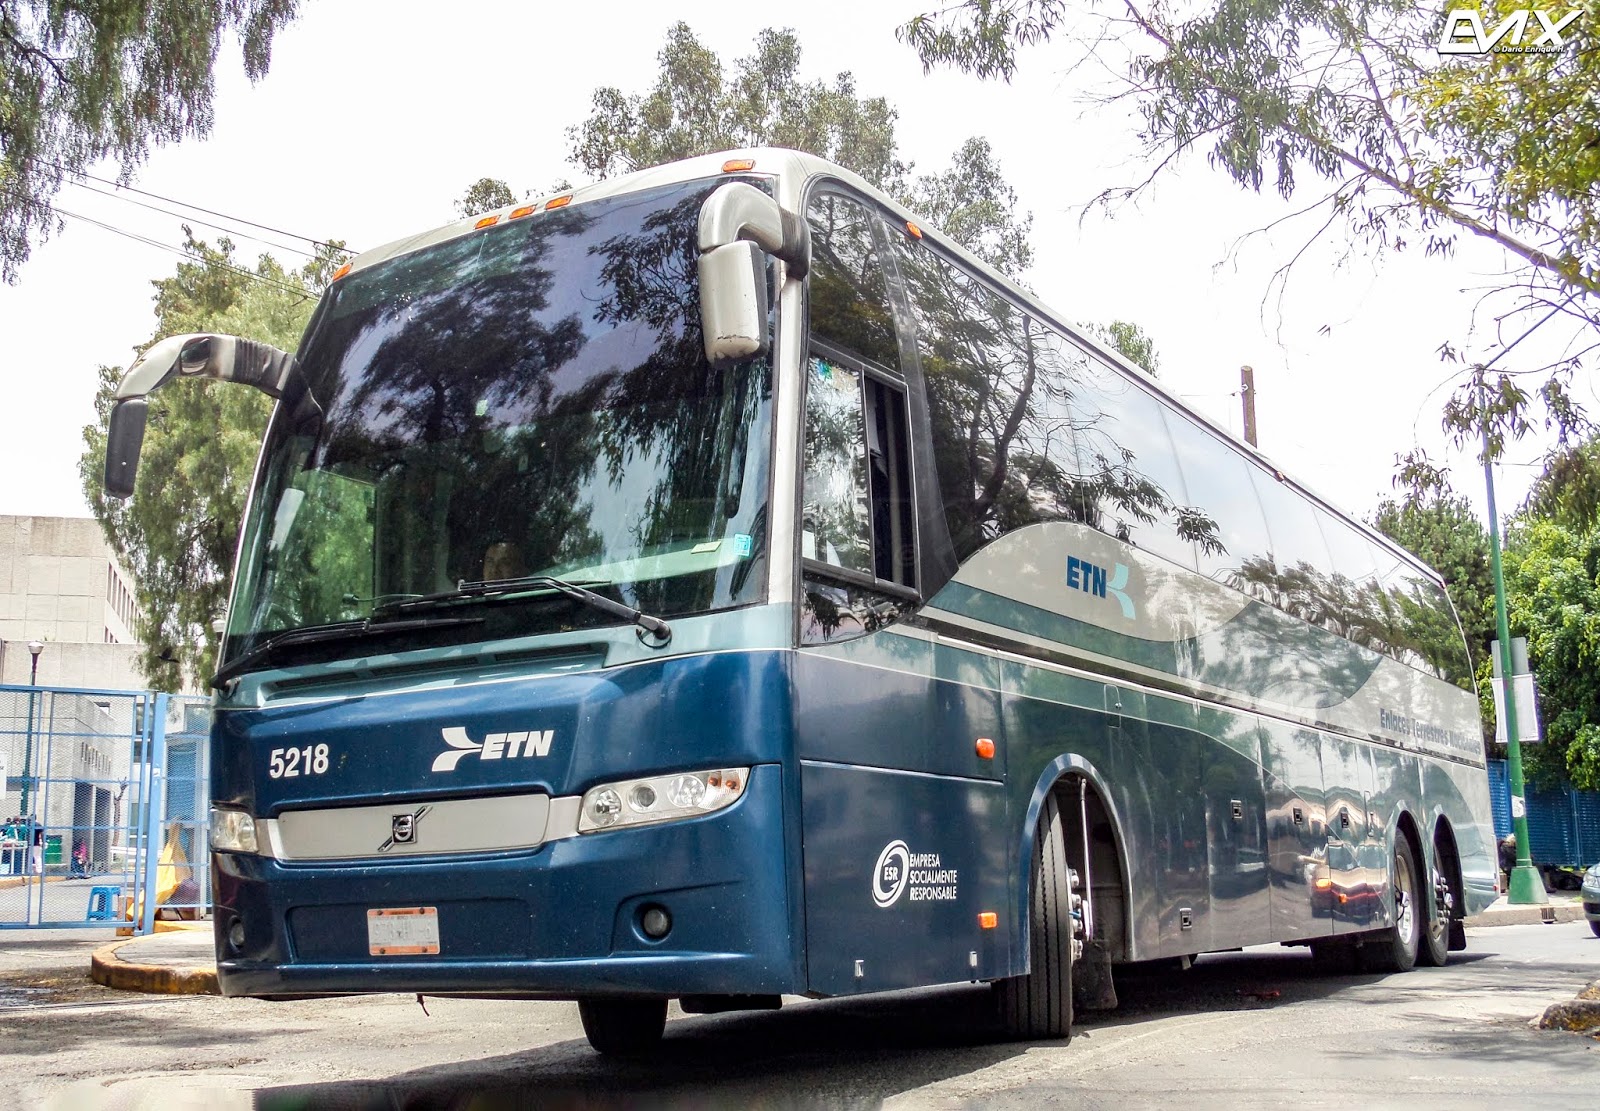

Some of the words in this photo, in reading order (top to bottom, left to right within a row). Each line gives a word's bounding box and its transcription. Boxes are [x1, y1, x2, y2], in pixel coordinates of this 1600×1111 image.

[1066, 555, 1107, 599] ETN
[1380, 708, 1410, 735] Enlaces
[480, 730, 555, 760] ETN
[269, 743, 329, 779] 5218
[909, 853, 940, 867] EMPRESA
[884, 867, 898, 880] ESR
[909, 870, 958, 884] SOCIALMENTE
[909, 886, 956, 900] RESPONSABLE
